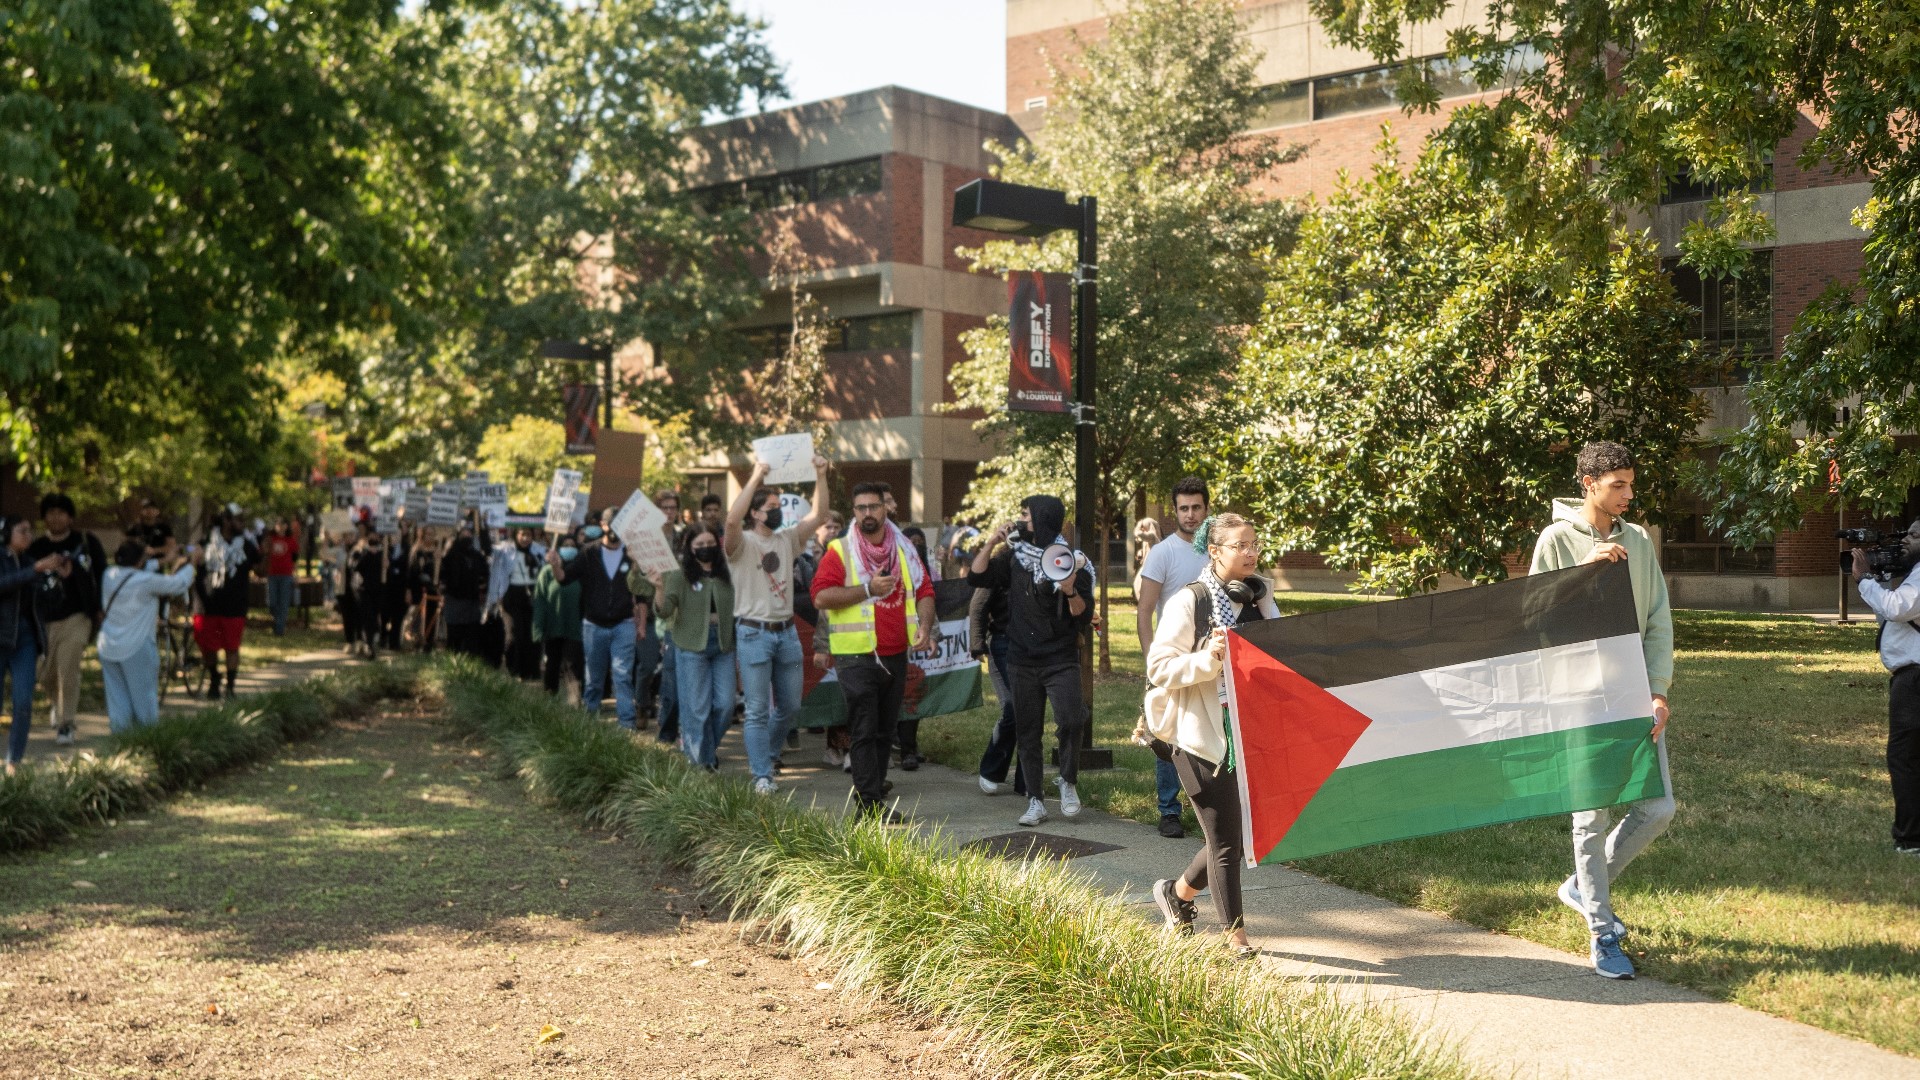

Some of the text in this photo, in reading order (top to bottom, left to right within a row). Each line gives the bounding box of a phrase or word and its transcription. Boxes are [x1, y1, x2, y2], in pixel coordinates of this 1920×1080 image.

[1030, 301, 1044, 368] DEFY
[1044, 303, 1052, 368] EXPECTATION
[1025, 394, 1062, 402] LOUISVILLE
